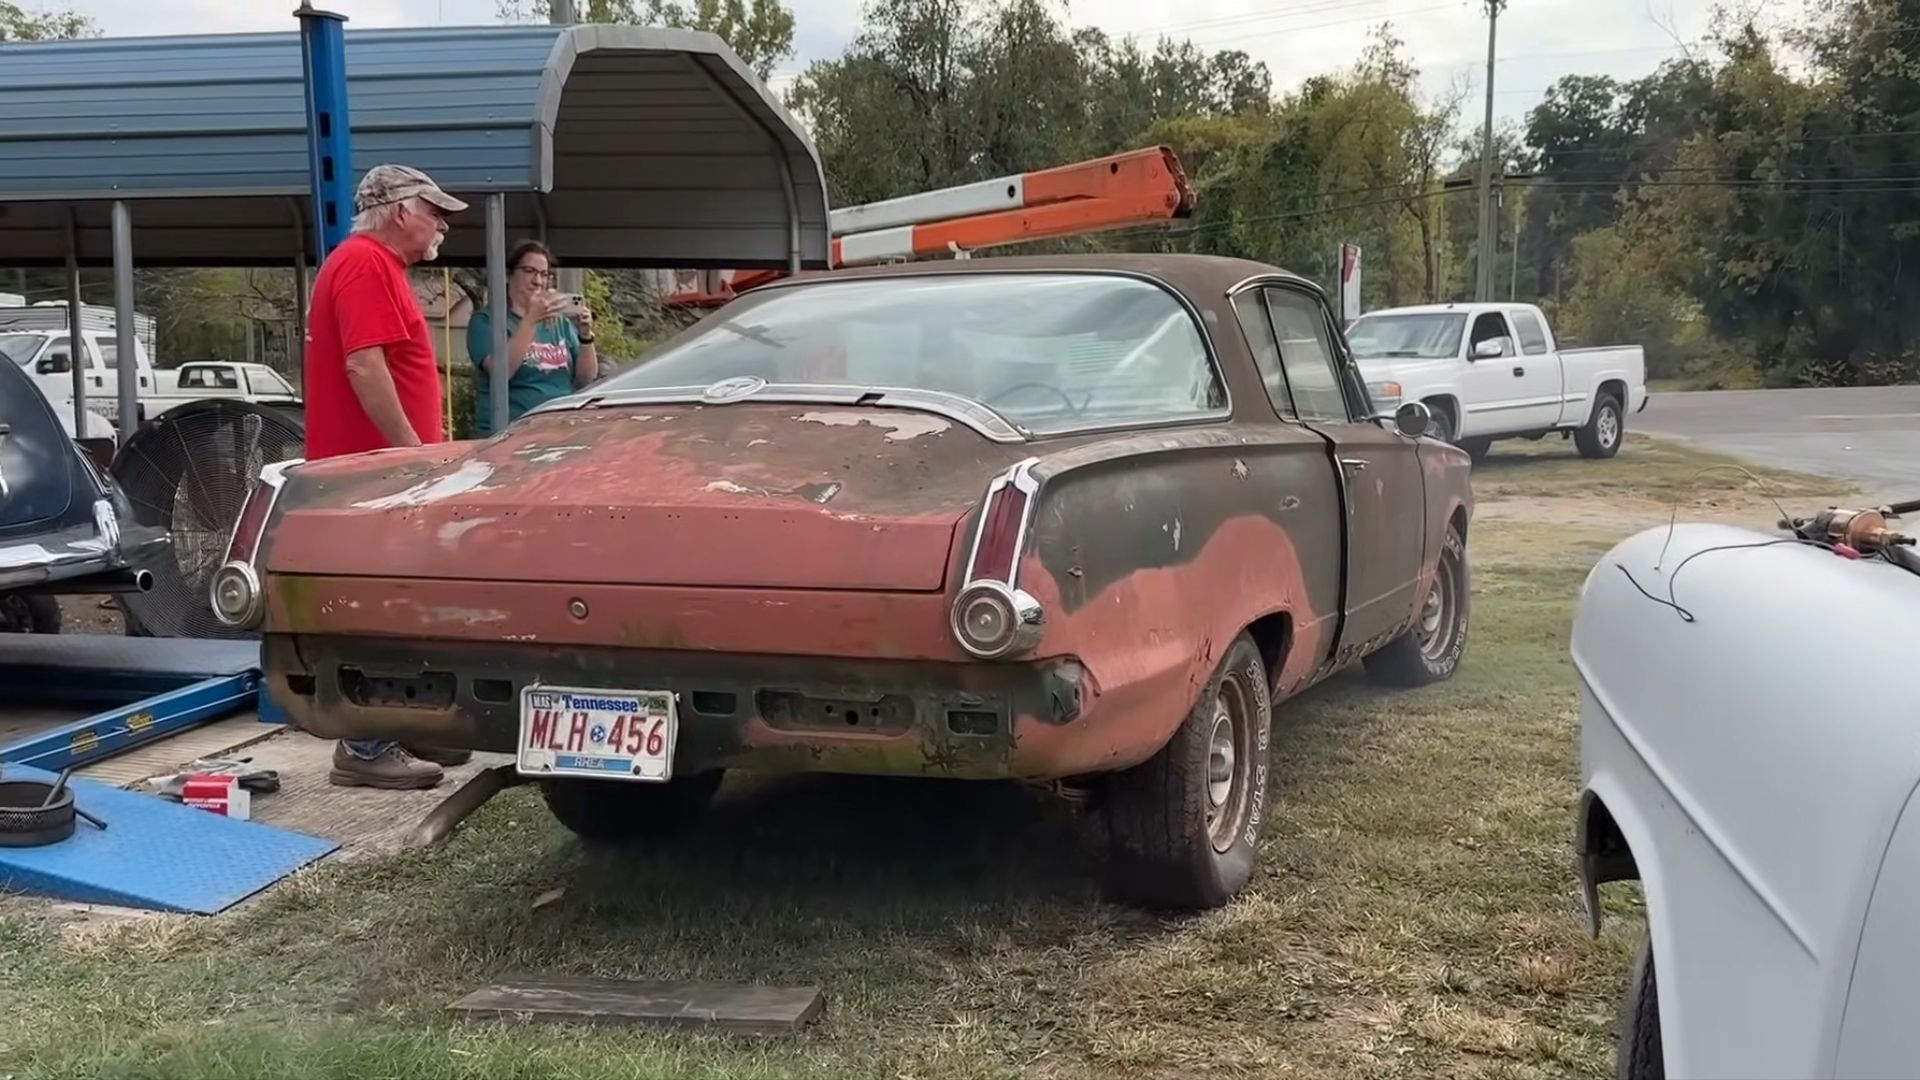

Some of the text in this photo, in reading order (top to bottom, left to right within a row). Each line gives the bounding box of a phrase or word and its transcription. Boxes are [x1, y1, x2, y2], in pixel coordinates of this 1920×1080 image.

[562, 695, 638, 712] Tennessee
[529, 710, 665, 756] MLH 456
